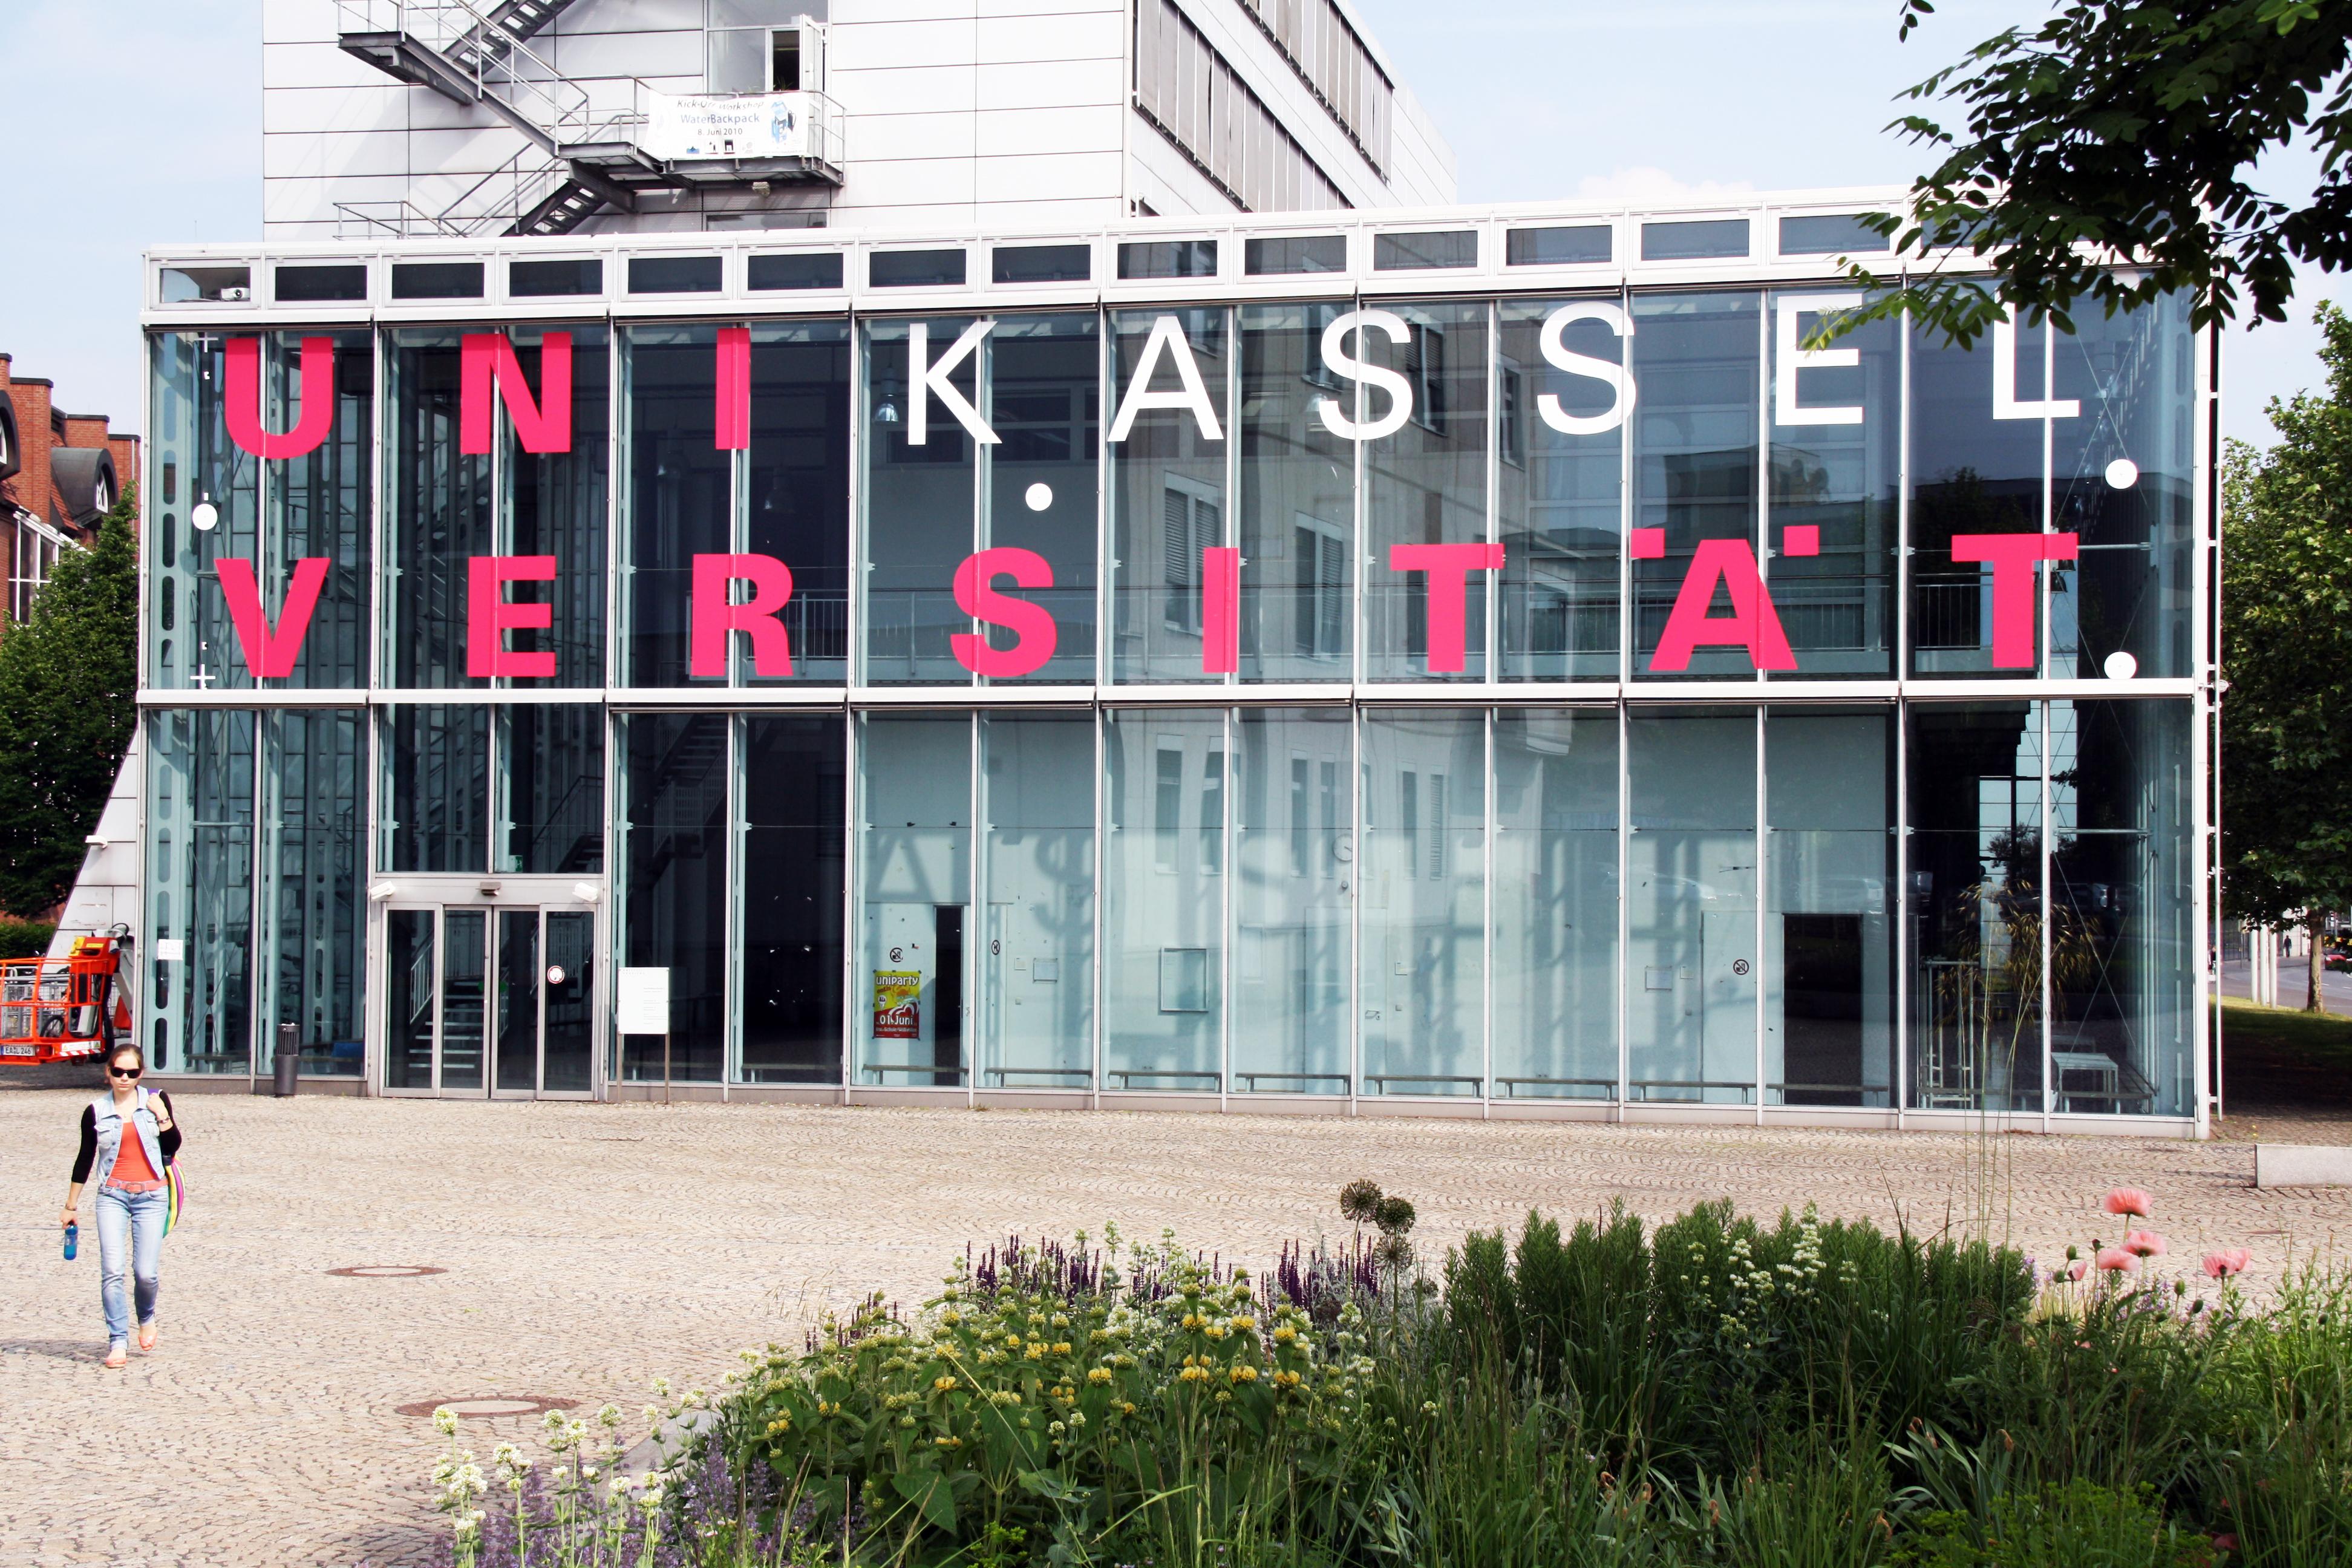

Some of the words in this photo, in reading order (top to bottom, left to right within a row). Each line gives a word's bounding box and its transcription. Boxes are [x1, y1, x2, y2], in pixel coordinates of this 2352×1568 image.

[681, 113, 760, 125] WaterBackpack
[225, 330, 751, 460] UNI
[908, 288, 2080, 445] KASSEL
[215, 525, 2079, 678] VERSITÄT
[876, 975, 918, 985] uniparty
[894, 1015, 913, 1025] Juni
